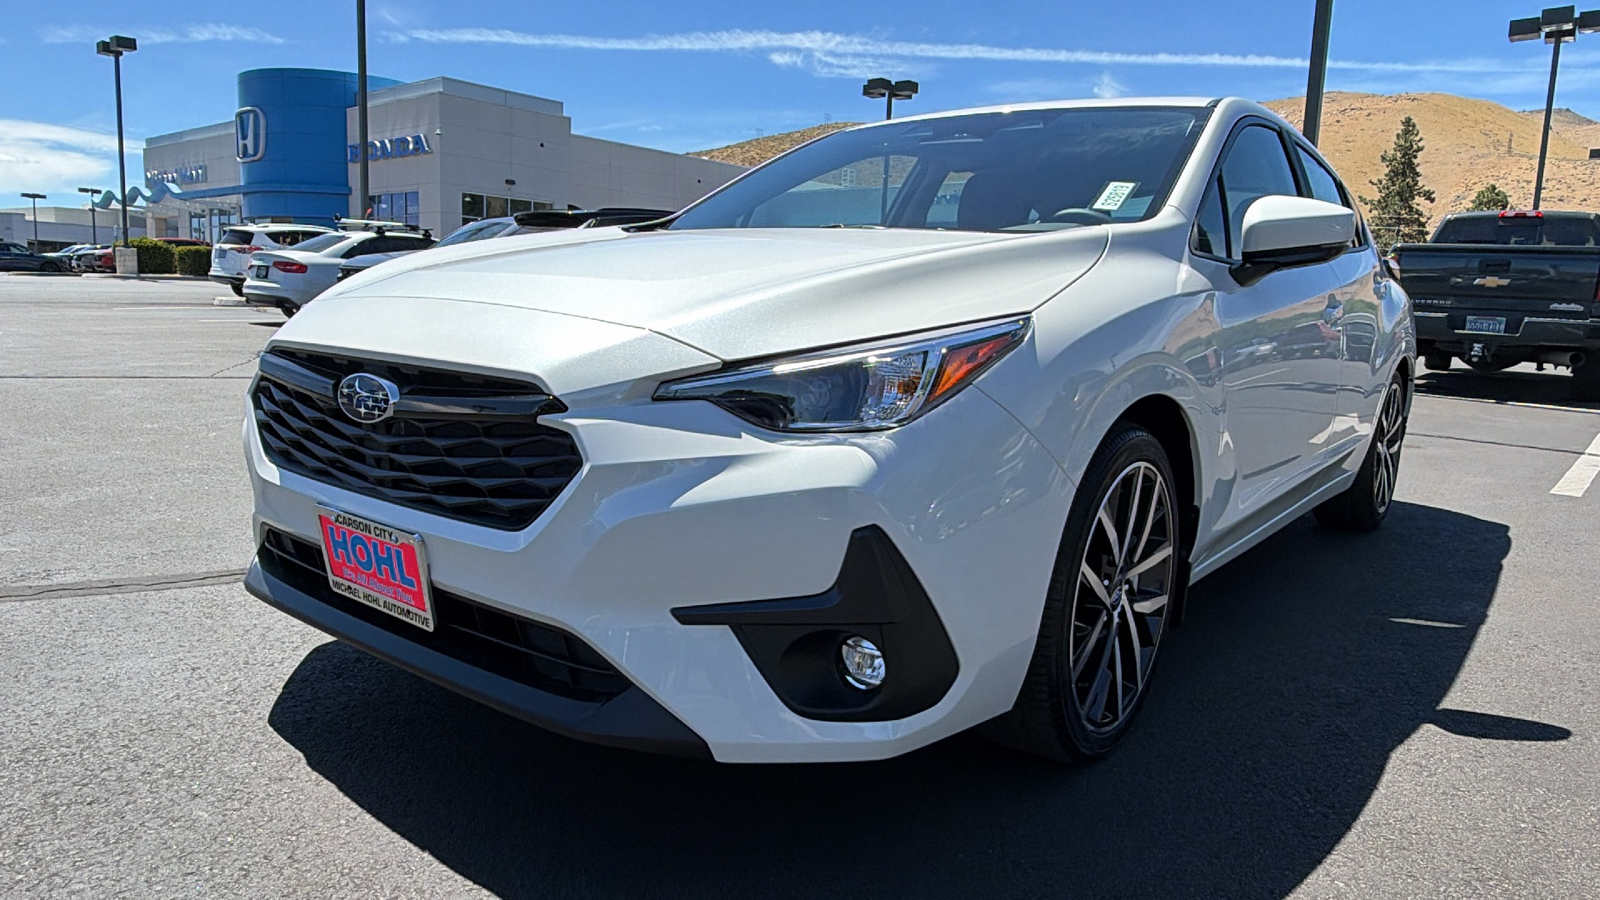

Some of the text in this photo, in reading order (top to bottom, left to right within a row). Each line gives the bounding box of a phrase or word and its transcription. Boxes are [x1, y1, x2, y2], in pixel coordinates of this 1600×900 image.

[348, 134, 433, 162] HONDA
[336, 514, 394, 541] CARSON CITY
[327, 525, 417, 590] HOHL
[368, 577, 394, 595] About
[332, 579, 430, 628] MICHAEL HOHL AUTOMOTIVE
